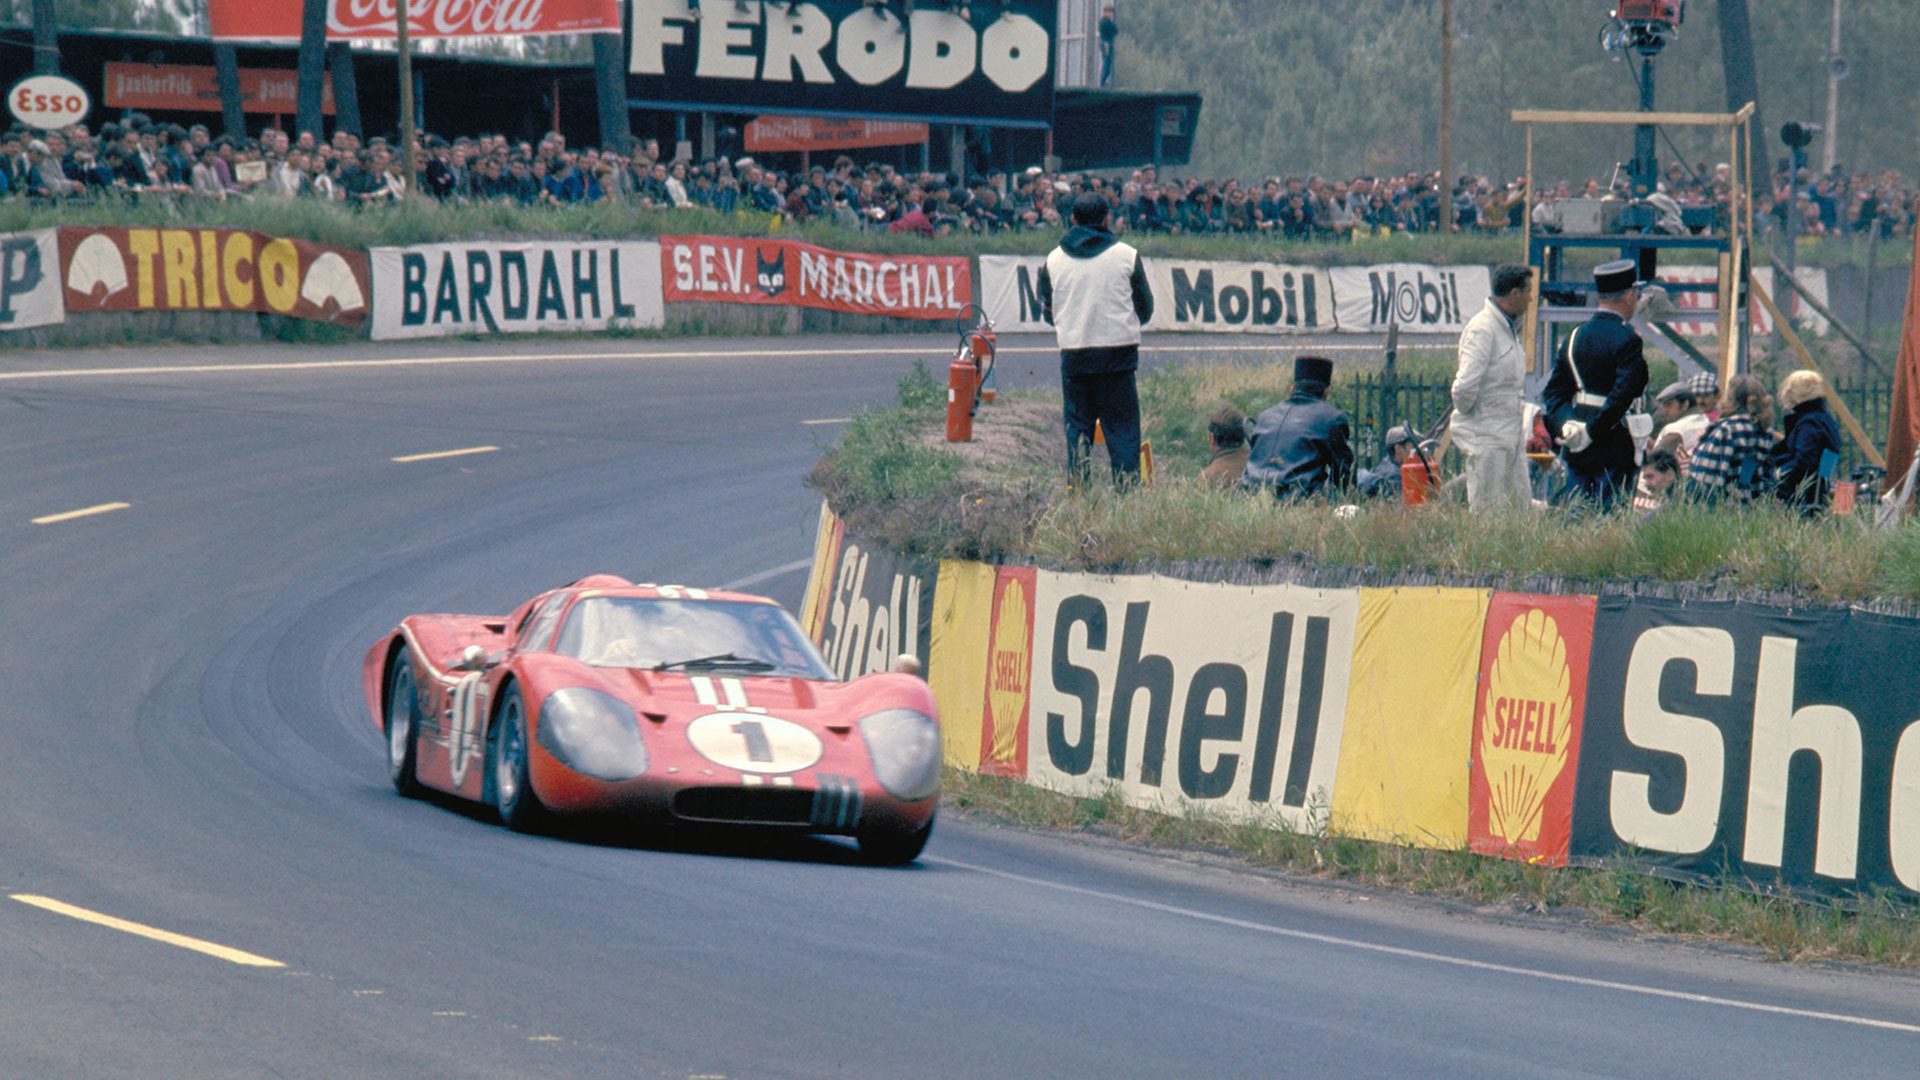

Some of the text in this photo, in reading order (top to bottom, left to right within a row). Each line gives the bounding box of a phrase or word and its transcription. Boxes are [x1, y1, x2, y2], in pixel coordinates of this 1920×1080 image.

[629, 0, 1049, 93] FERODO
[17, 88, 82, 113] Esso
[129, 229, 300, 311] TRICO
[401, 248, 636, 332] BARDAHL
[673, 244, 751, 294] S.E.V.
[800, 250, 963, 310] MARCHAL
[1171, 267, 1319, 328] Mobil
[1369, 271, 1462, 325] Mobil
[823, 544, 921, 683] Shell
[995, 649, 1023, 694] SHELL
[1046, 593, 1330, 809] Shell
[730, 720, 775, 763] 1
[1492, 696, 1557, 755] SHELL
